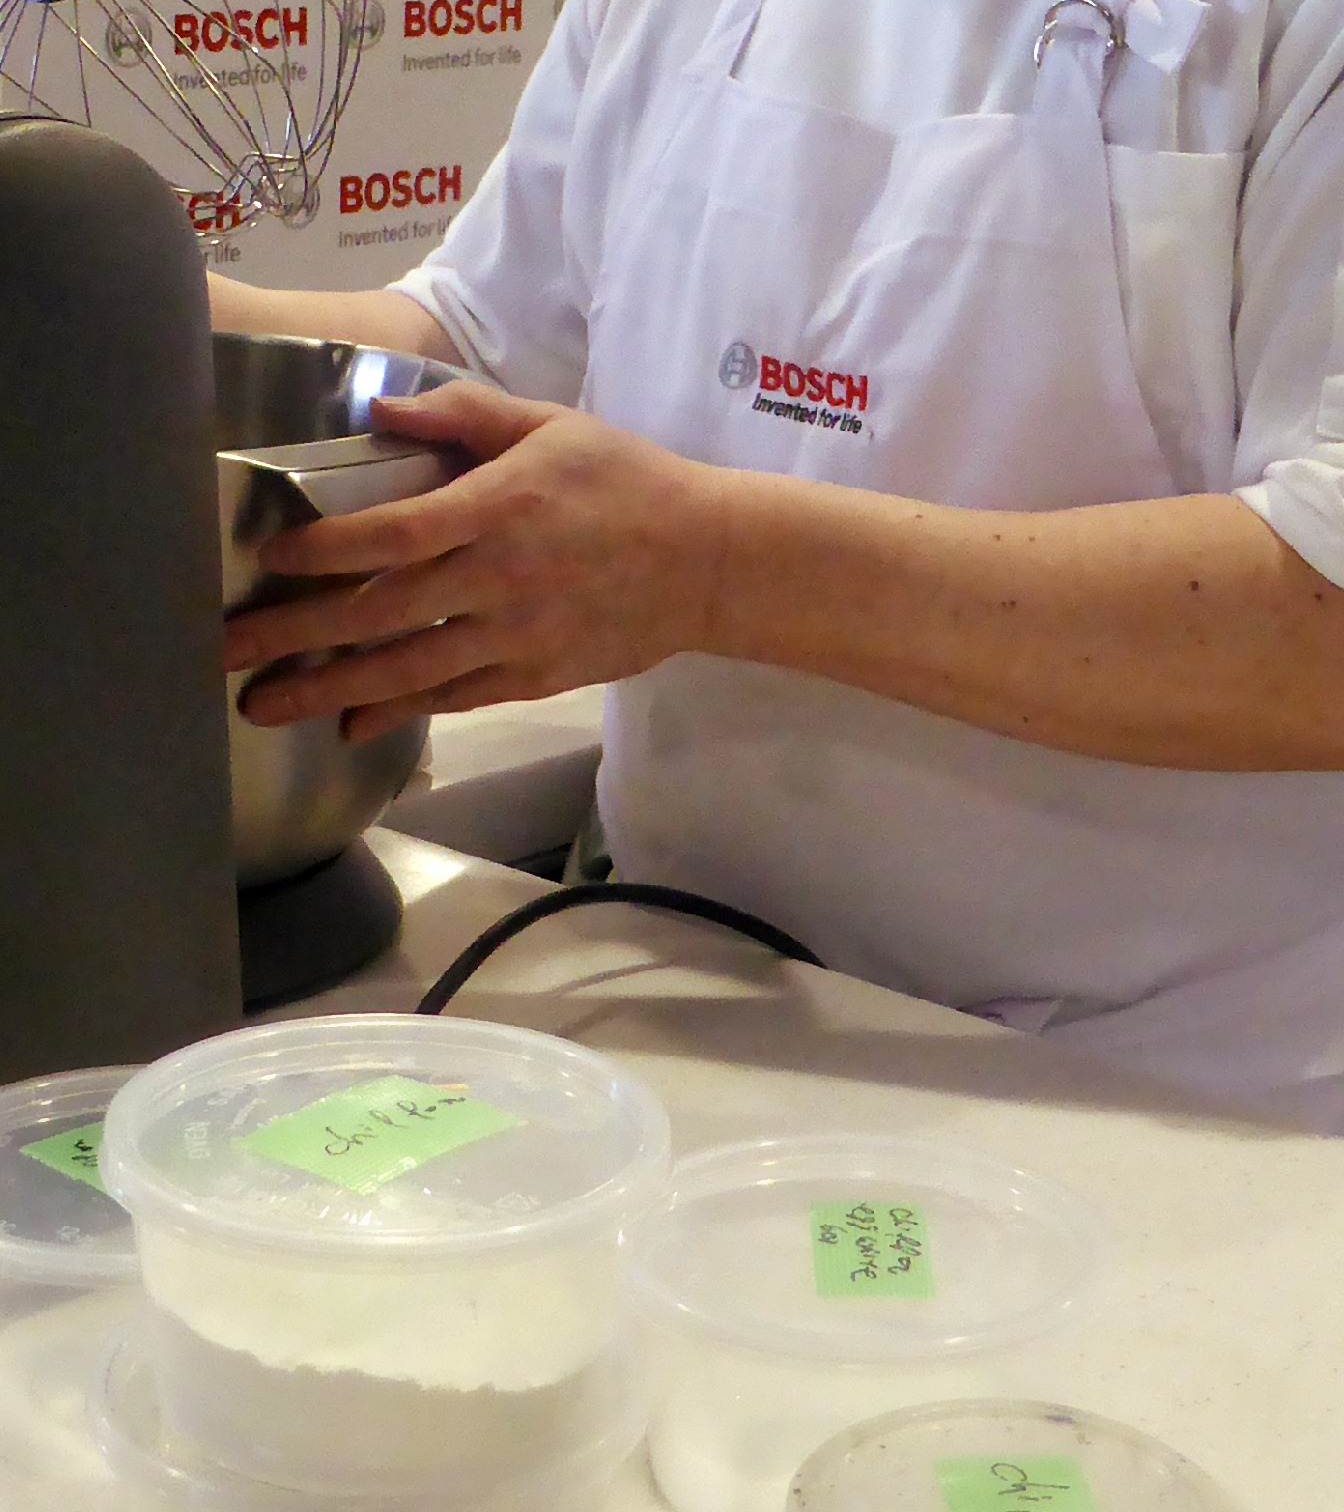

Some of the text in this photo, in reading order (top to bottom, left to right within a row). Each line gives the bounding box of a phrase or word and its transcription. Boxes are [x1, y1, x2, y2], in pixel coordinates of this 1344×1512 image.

[174, 7, 308, 56] BOSCH
[402, 45, 521, 72] Invented for life
[340, 164, 462, 214] BOSCH
[214, 243, 241, 264] life
[338, 222, 409, 248] Invented
[413, 220, 434, 238] for
[759, 355, 868, 411] BOSCH
[752, 393, 863, 434] Invented for life
